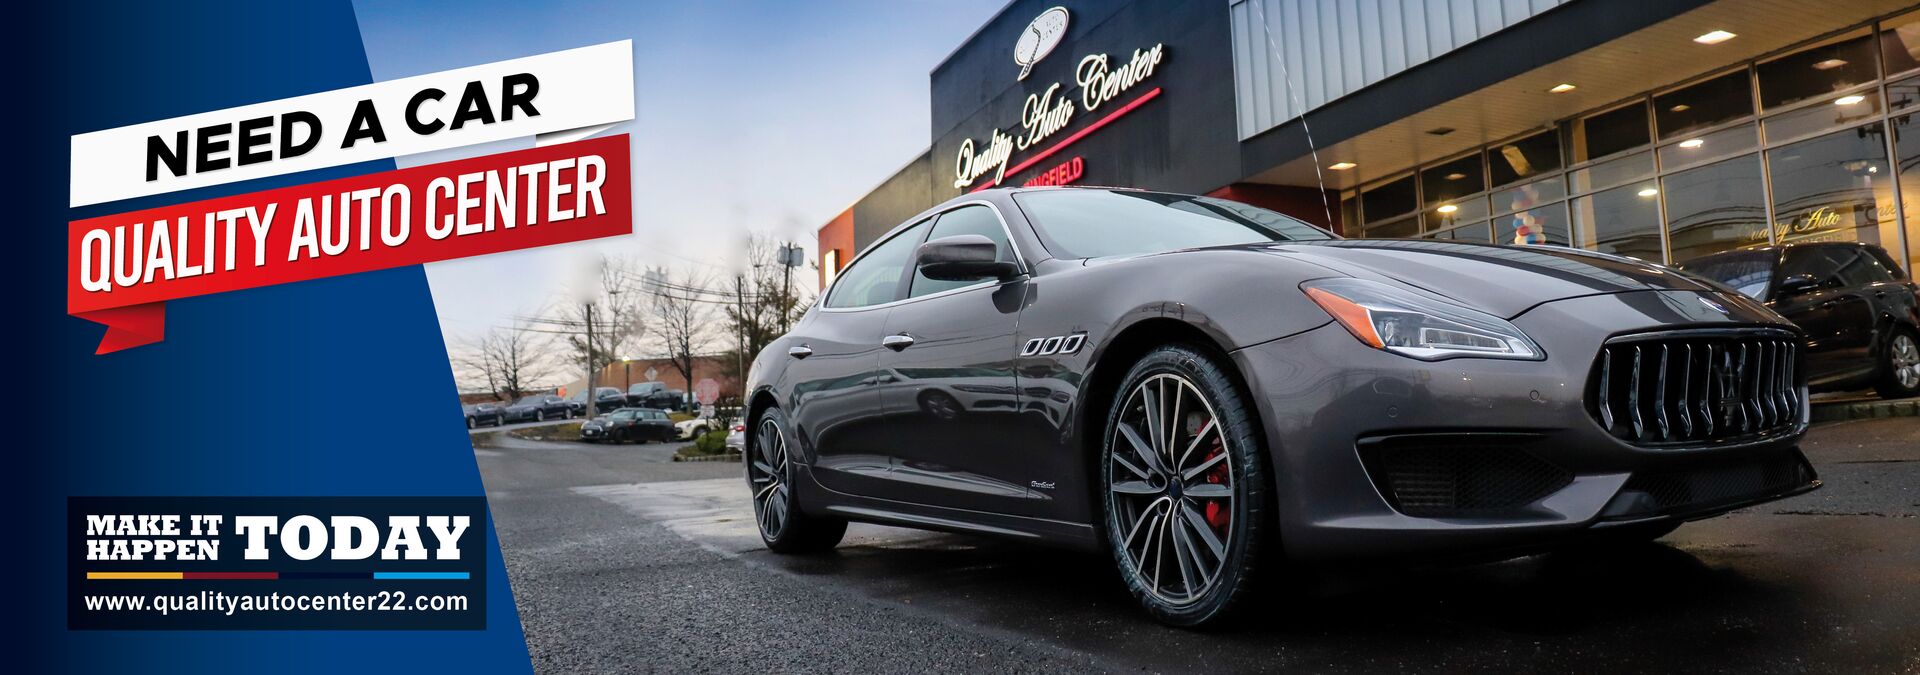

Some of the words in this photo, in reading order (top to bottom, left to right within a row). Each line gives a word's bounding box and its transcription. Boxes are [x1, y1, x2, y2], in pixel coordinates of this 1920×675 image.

[954, 128, 1013, 188] Quality
[1017, 83, 1074, 150] Auto
[1076, 43, 1162, 111] Center
[1795, 206, 1840, 232] Auto
